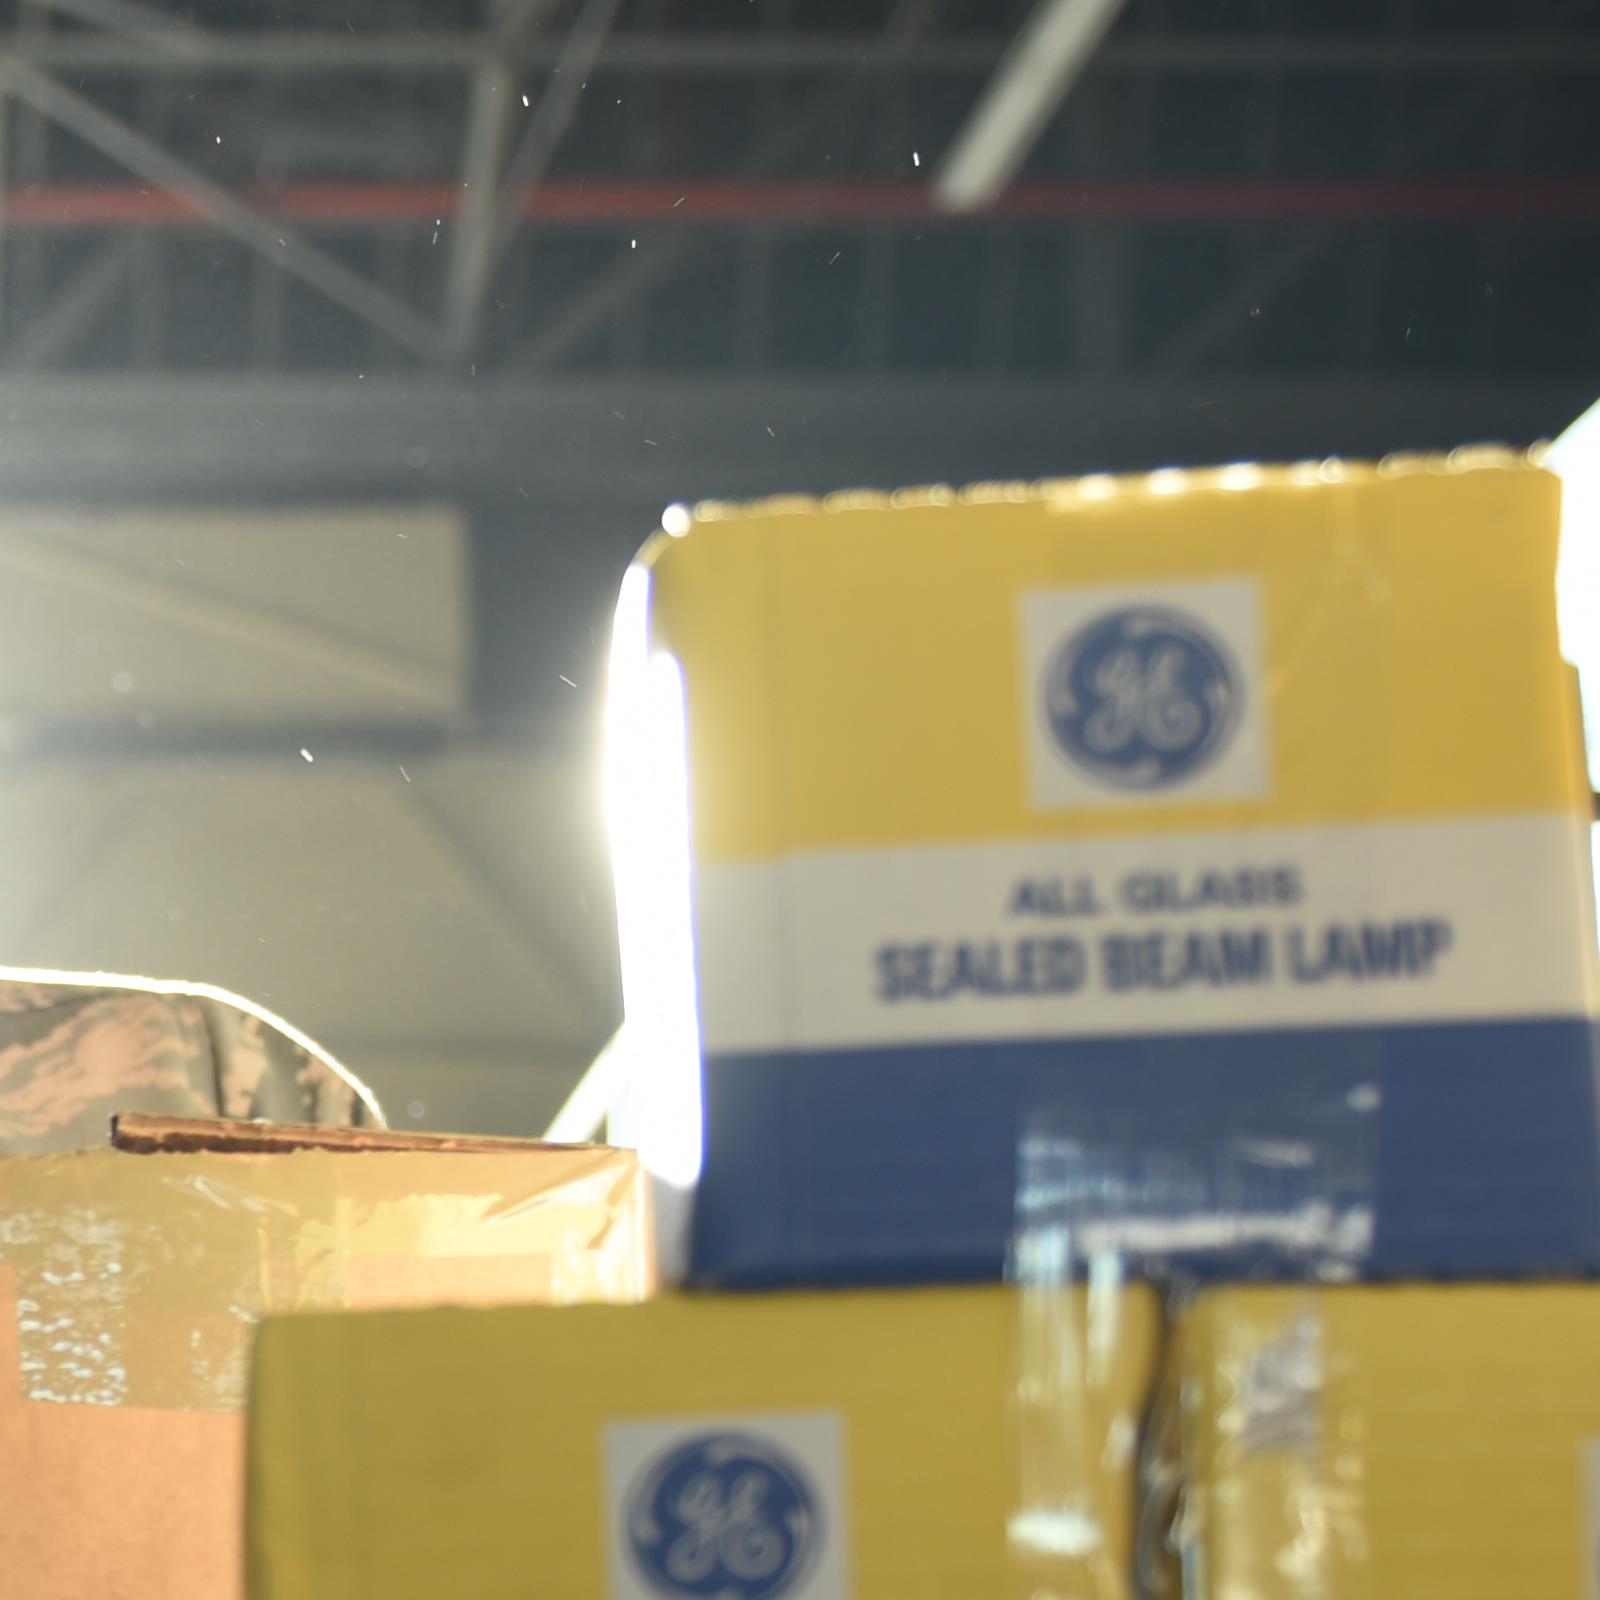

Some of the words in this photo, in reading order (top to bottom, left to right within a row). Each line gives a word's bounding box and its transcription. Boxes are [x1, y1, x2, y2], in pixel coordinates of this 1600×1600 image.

[1009, 876, 1104, 919] ALL
[1118, 864, 1306, 915] GLASS
[873, 932, 1089, 1004] SEALED
[1099, 925, 1276, 993] BEAM
[1286, 915, 1453, 985] LAMP
